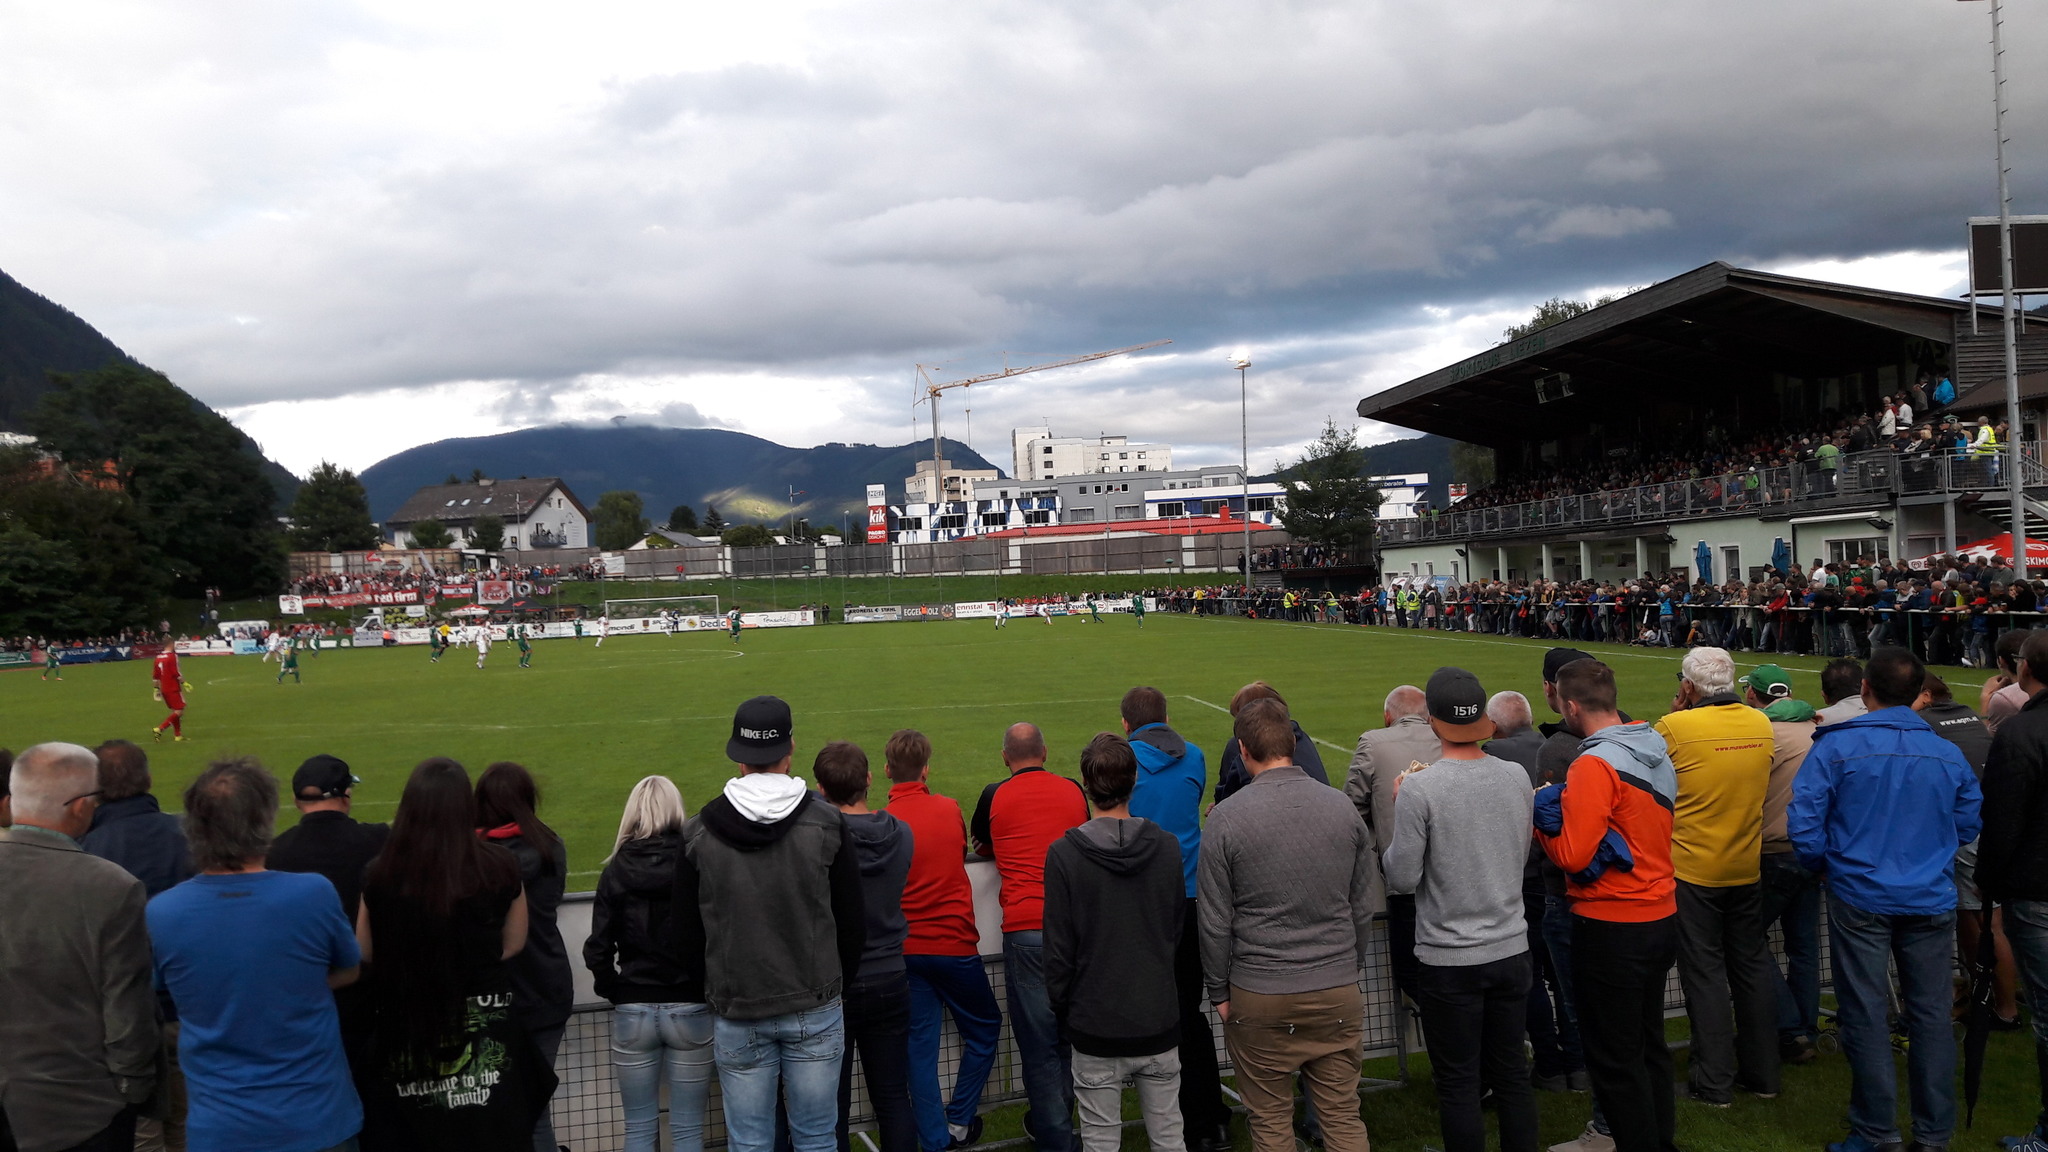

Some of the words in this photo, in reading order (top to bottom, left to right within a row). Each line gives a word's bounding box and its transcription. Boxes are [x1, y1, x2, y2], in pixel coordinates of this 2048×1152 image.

[956, 603, 982, 611] ennstal
[1453, 704, 1478, 716] 1516
[740, 727, 761, 740] NIKE
[762, 729, 780, 740] F.C.
[462, 1073, 476, 1088] to
[481, 1069, 501, 1087] the
[447, 1086, 491, 1109] family
